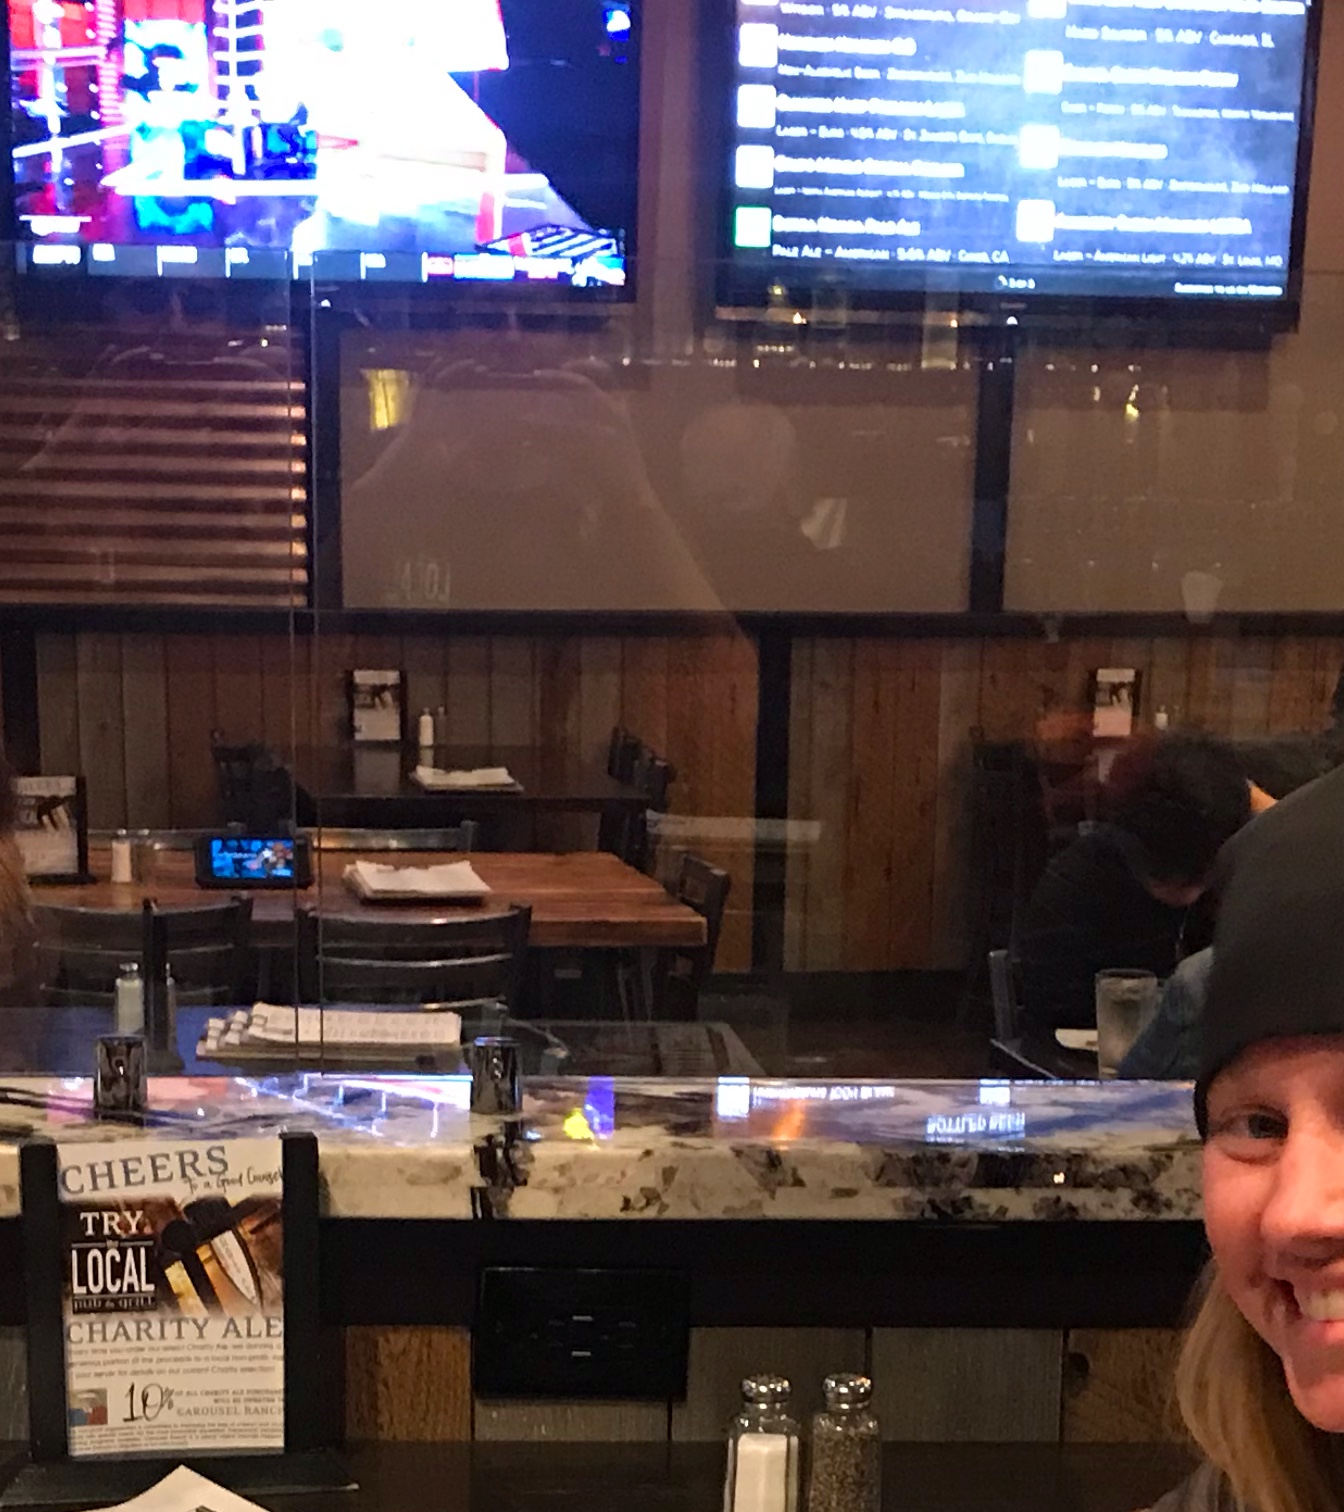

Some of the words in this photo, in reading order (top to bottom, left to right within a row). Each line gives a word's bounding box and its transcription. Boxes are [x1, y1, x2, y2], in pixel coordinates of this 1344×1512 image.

[60, 1145, 229, 1194] CHEERS
[80, 1210, 144, 1237] TRY
[71, 1246, 155, 1294] LOCAL
[67, 1317, 210, 1345] CHARITY
[222, 1316, 283, 1340] ALE
